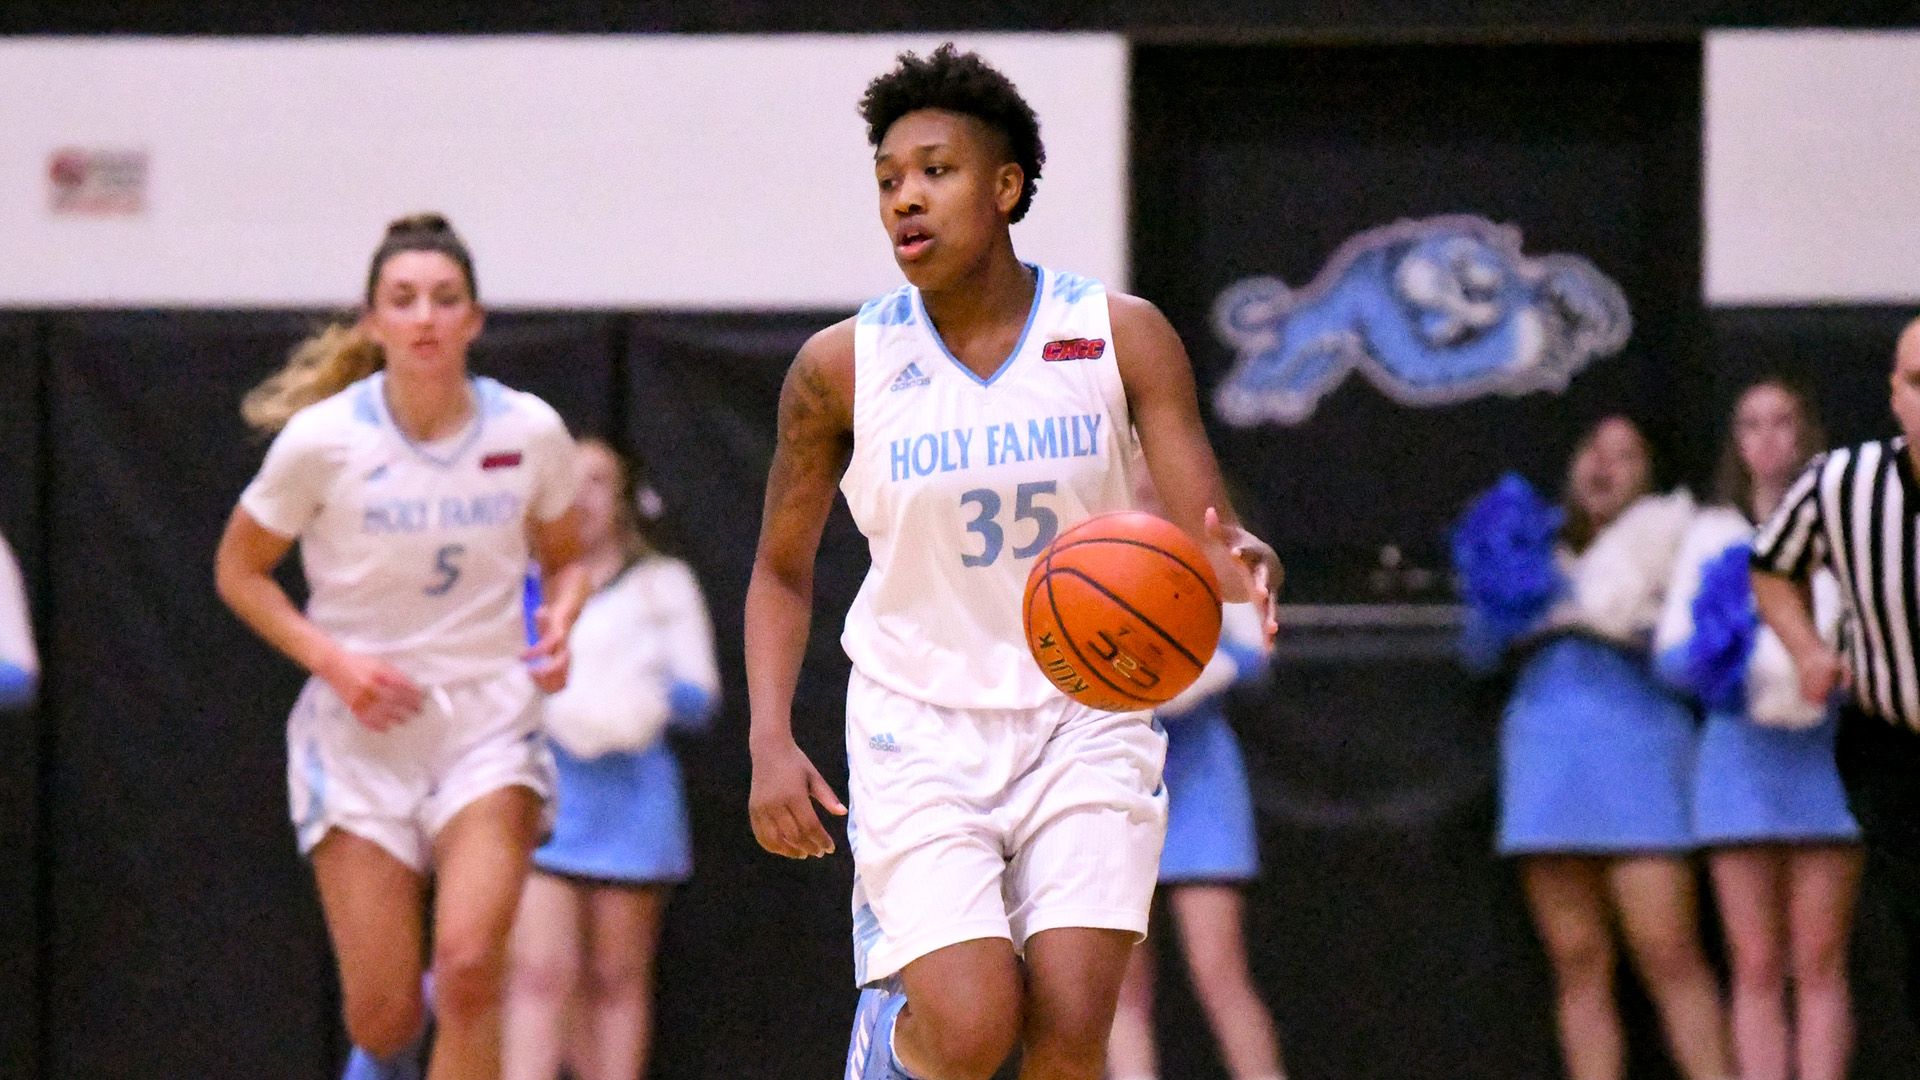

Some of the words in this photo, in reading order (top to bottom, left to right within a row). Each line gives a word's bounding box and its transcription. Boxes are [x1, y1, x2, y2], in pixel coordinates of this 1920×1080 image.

[890, 376, 931, 391] adidas
[890, 427, 974, 482] HOLY
[985, 413, 1102, 466] FAMILY
[960, 480, 1059, 568] 35
[423, 543, 465, 597] 5
